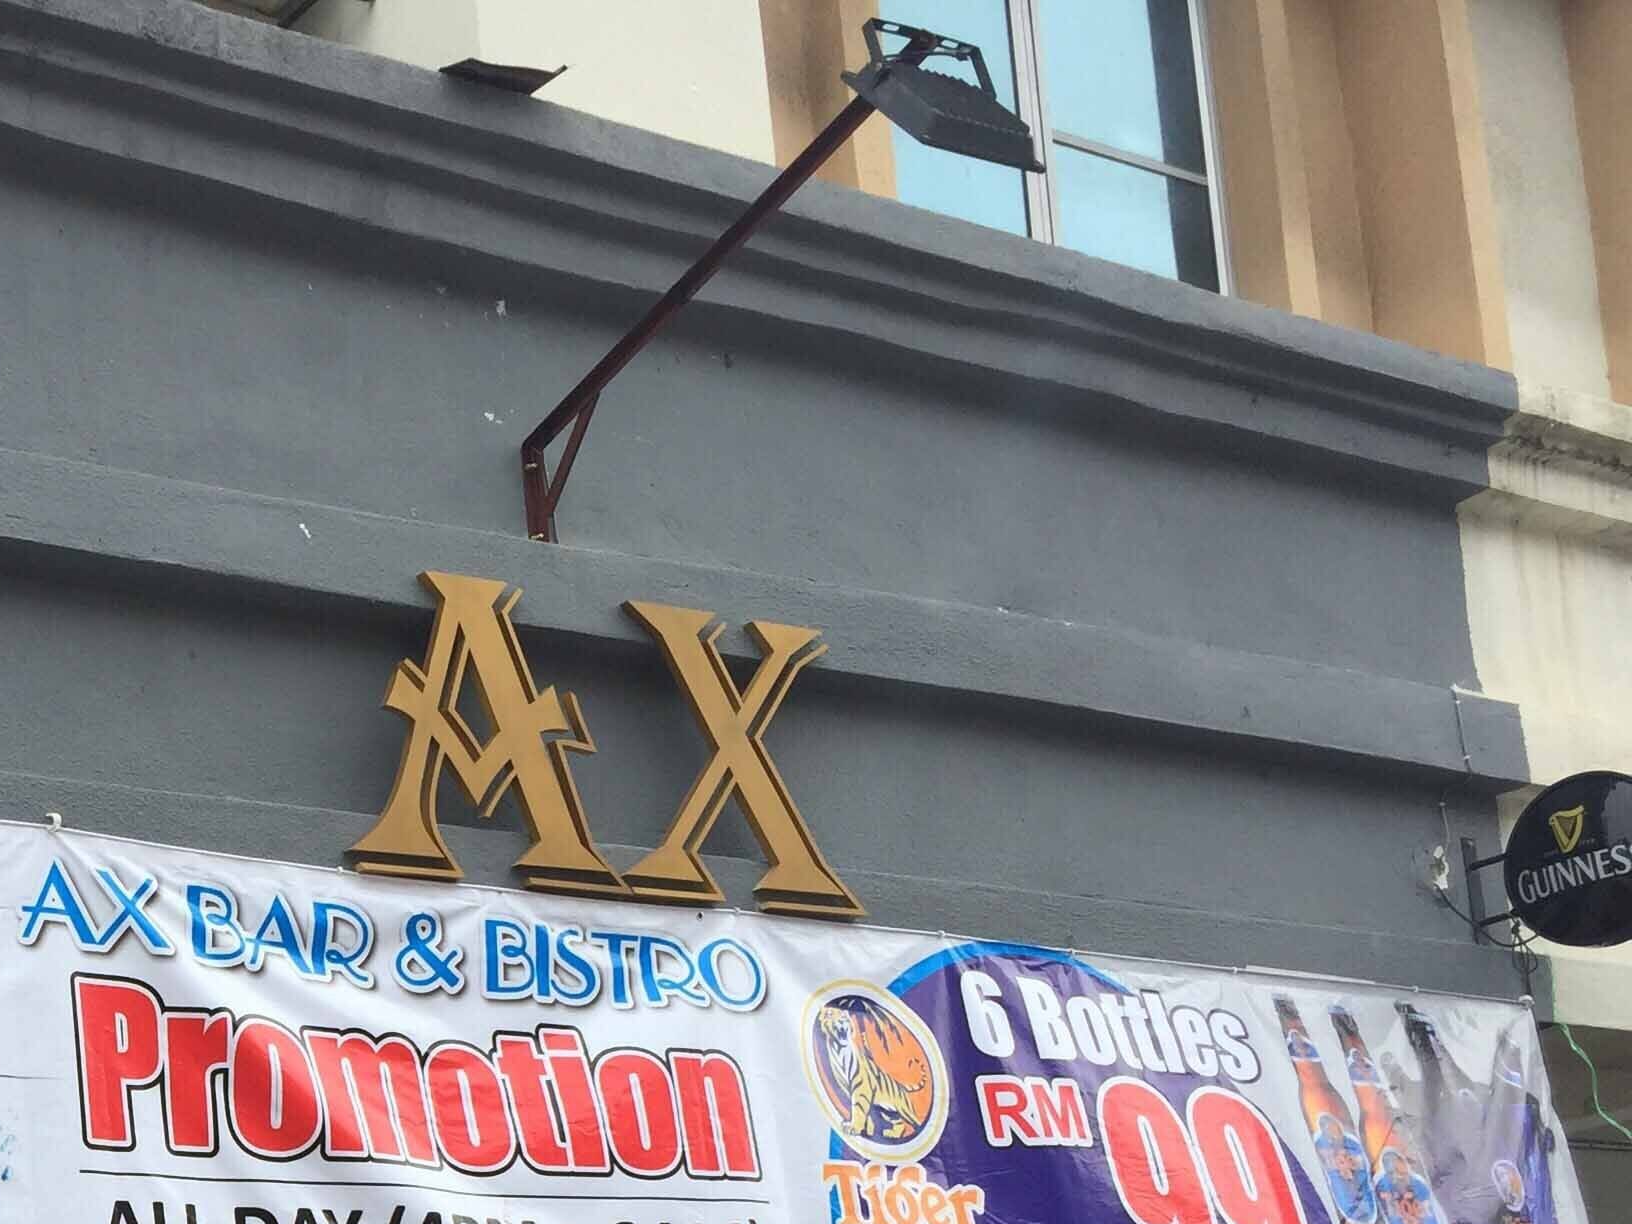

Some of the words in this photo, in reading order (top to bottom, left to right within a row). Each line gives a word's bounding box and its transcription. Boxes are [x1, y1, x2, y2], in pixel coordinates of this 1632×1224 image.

[344, 570, 866, 916] AX
[20, 858, 171, 952] AX
[187, 884, 372, 984] BAR
[395, 913, 463, 987] &
[486, 918, 766, 1010] BISTRO
[1518, 843, 1632, 904] GUINNES
[71, 971, 763, 1182] Promotion
[959, 971, 1016, 1061] 6
[1014, 974, 1262, 1084] Bottles
[979, 1076, 1092, 1148] RM
